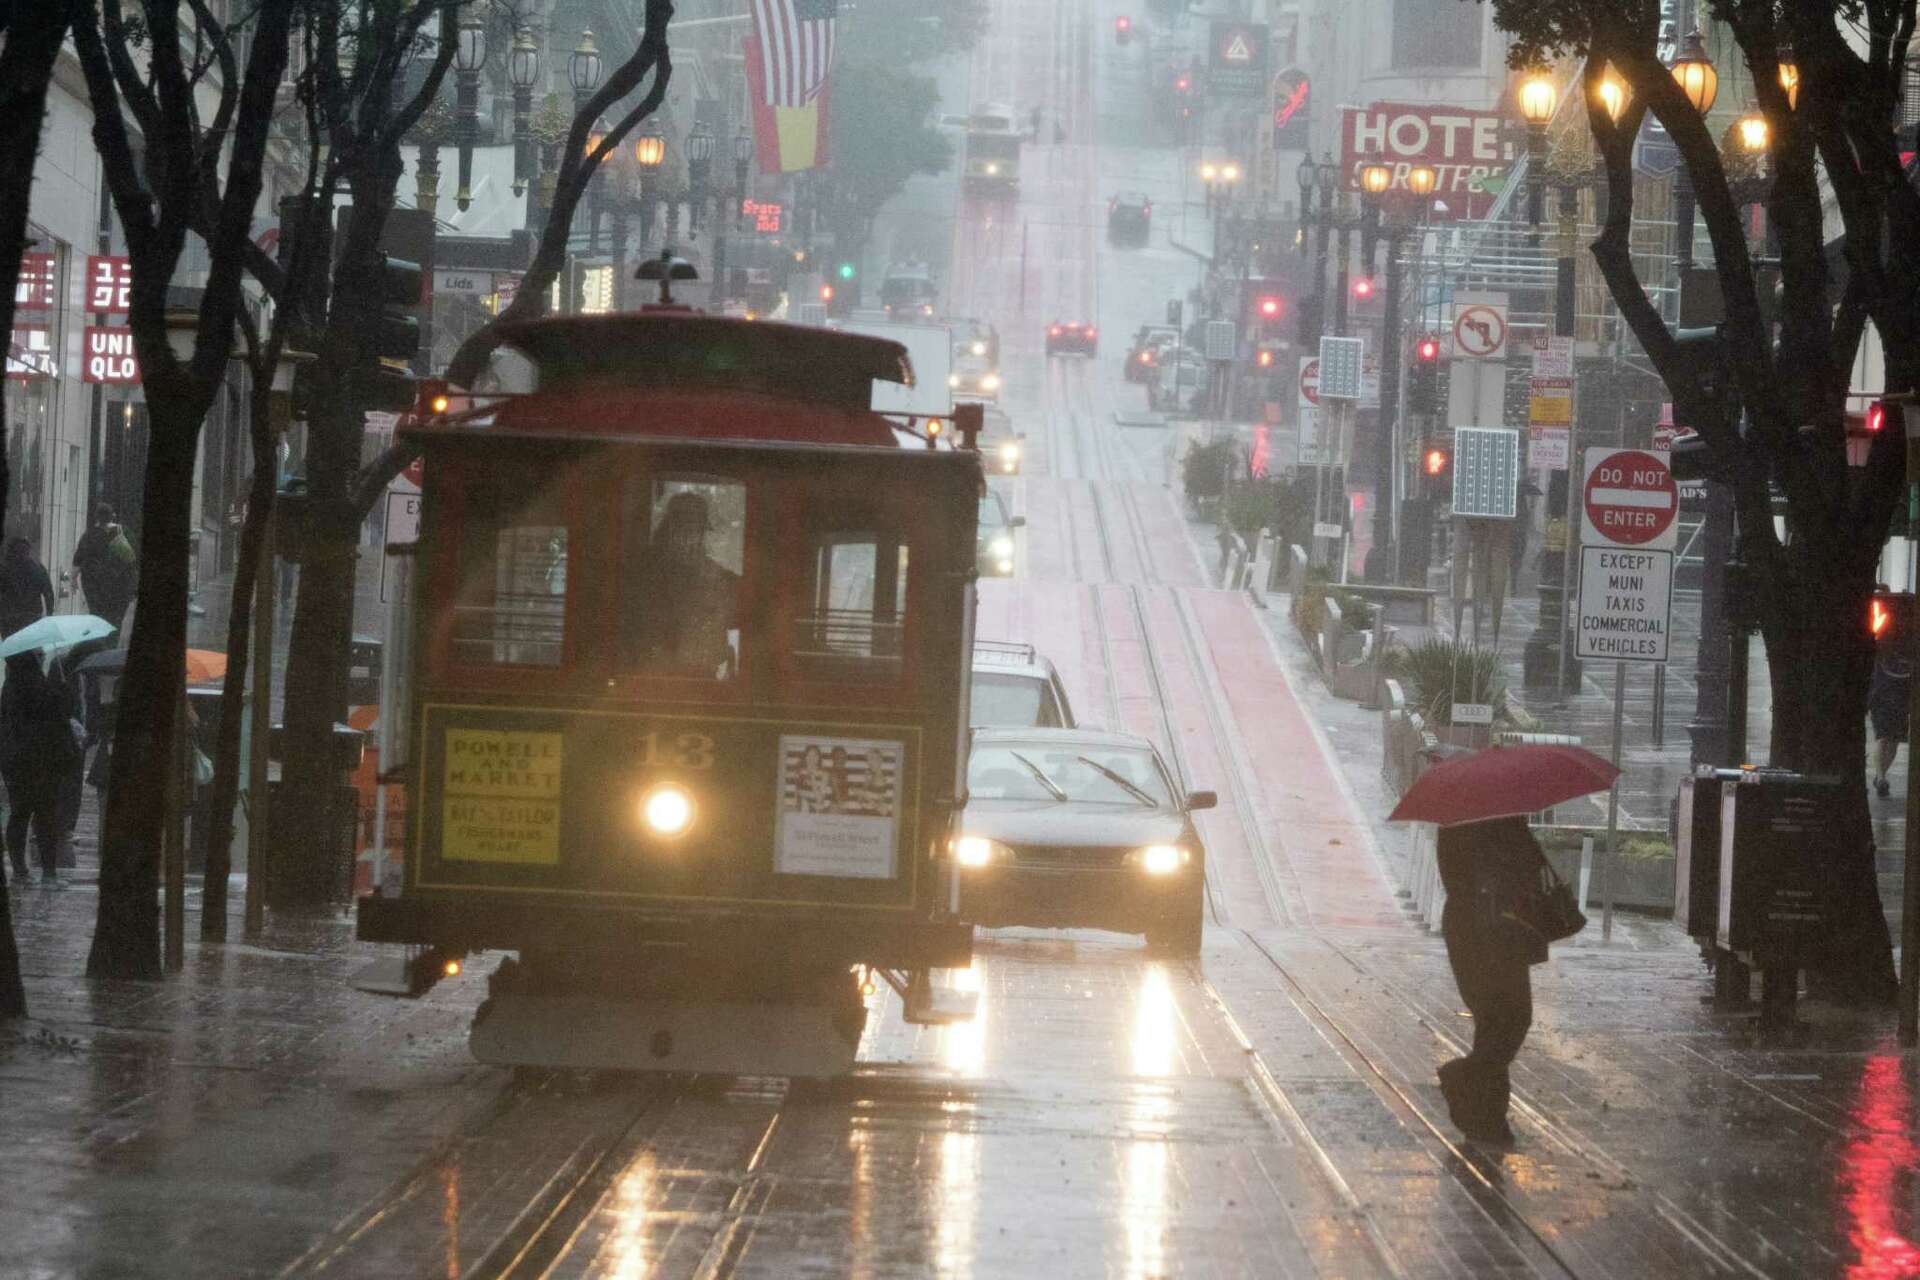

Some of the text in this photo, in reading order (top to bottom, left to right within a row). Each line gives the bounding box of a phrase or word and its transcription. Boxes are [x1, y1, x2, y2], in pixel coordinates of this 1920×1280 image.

[91, 333, 133, 355] UNI
[90, 356, 135, 380] QLO
[1600, 468, 1667, 486] DO NOT
[1603, 511, 1656, 527] ENTER
[1600, 553, 1654, 570] EXCEPT
[1608, 575, 1643, 591] MUNI
[1606, 596, 1646, 612] TAXIS
[1583, 615, 1664, 633] COMMERCIAL
[1589, 637, 1656, 655] VEHICLES
[454, 740, 553, 758] POWELL
[637, 732, 716, 769] 13
[480, 759, 531, 769] AND
[450, 770, 555, 788] MARKET
